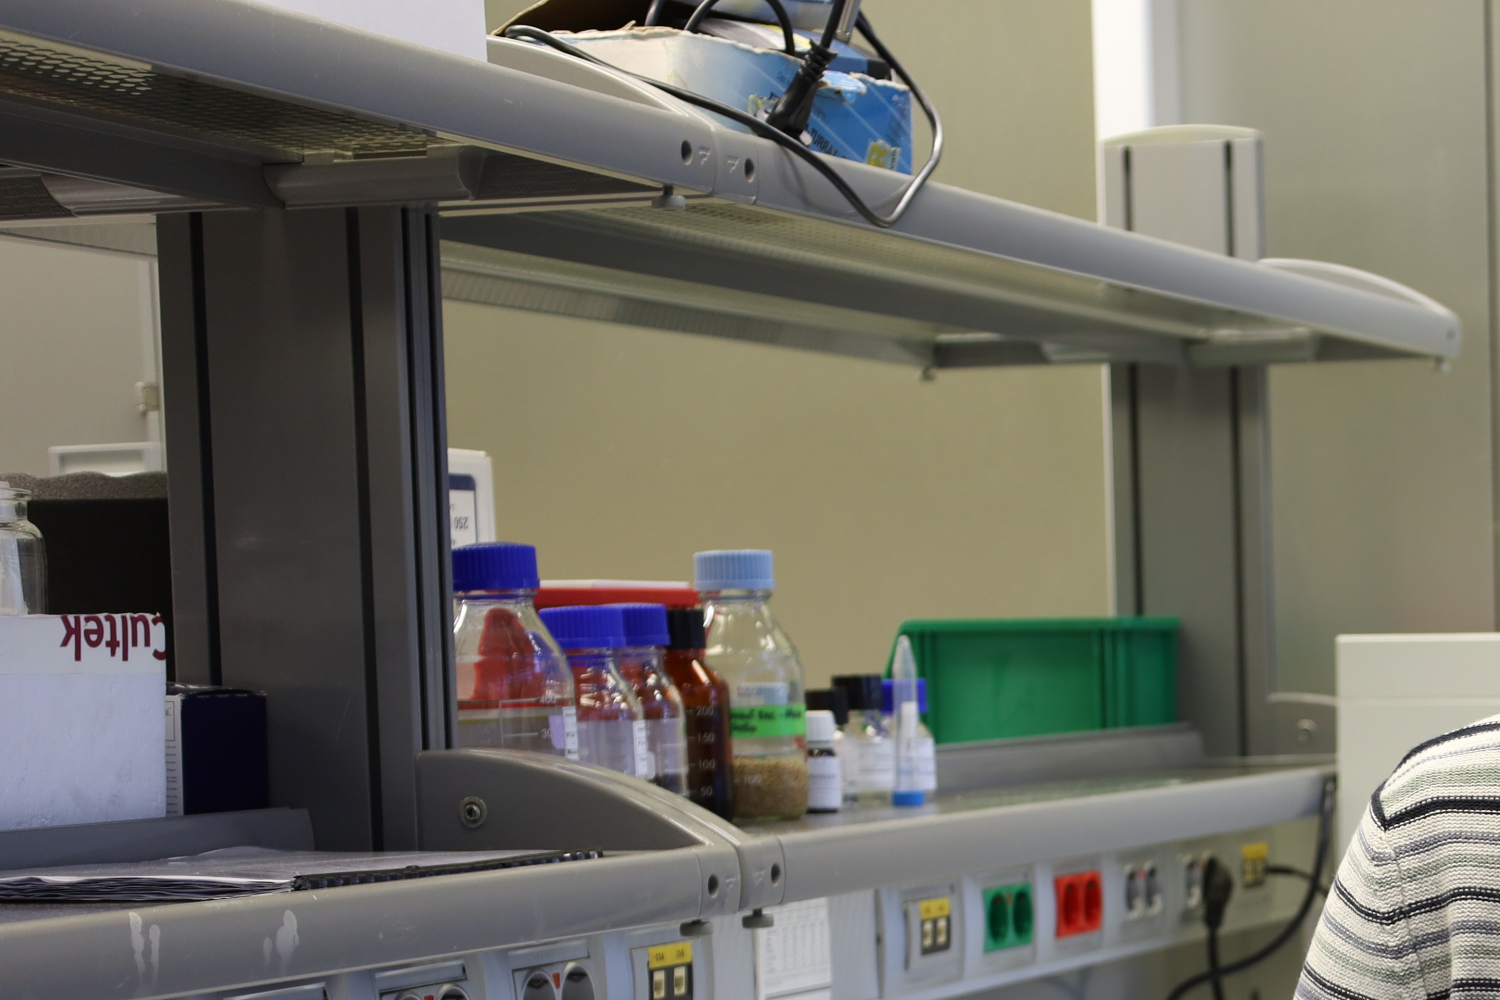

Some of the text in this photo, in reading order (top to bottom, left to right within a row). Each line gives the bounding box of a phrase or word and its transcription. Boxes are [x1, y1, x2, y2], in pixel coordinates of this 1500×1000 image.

[696, 706, 714, 716] 200
[697, 733, 715, 743] 150
[698, 759, 716, 769] 100
[700, 787, 713, 796] 50
